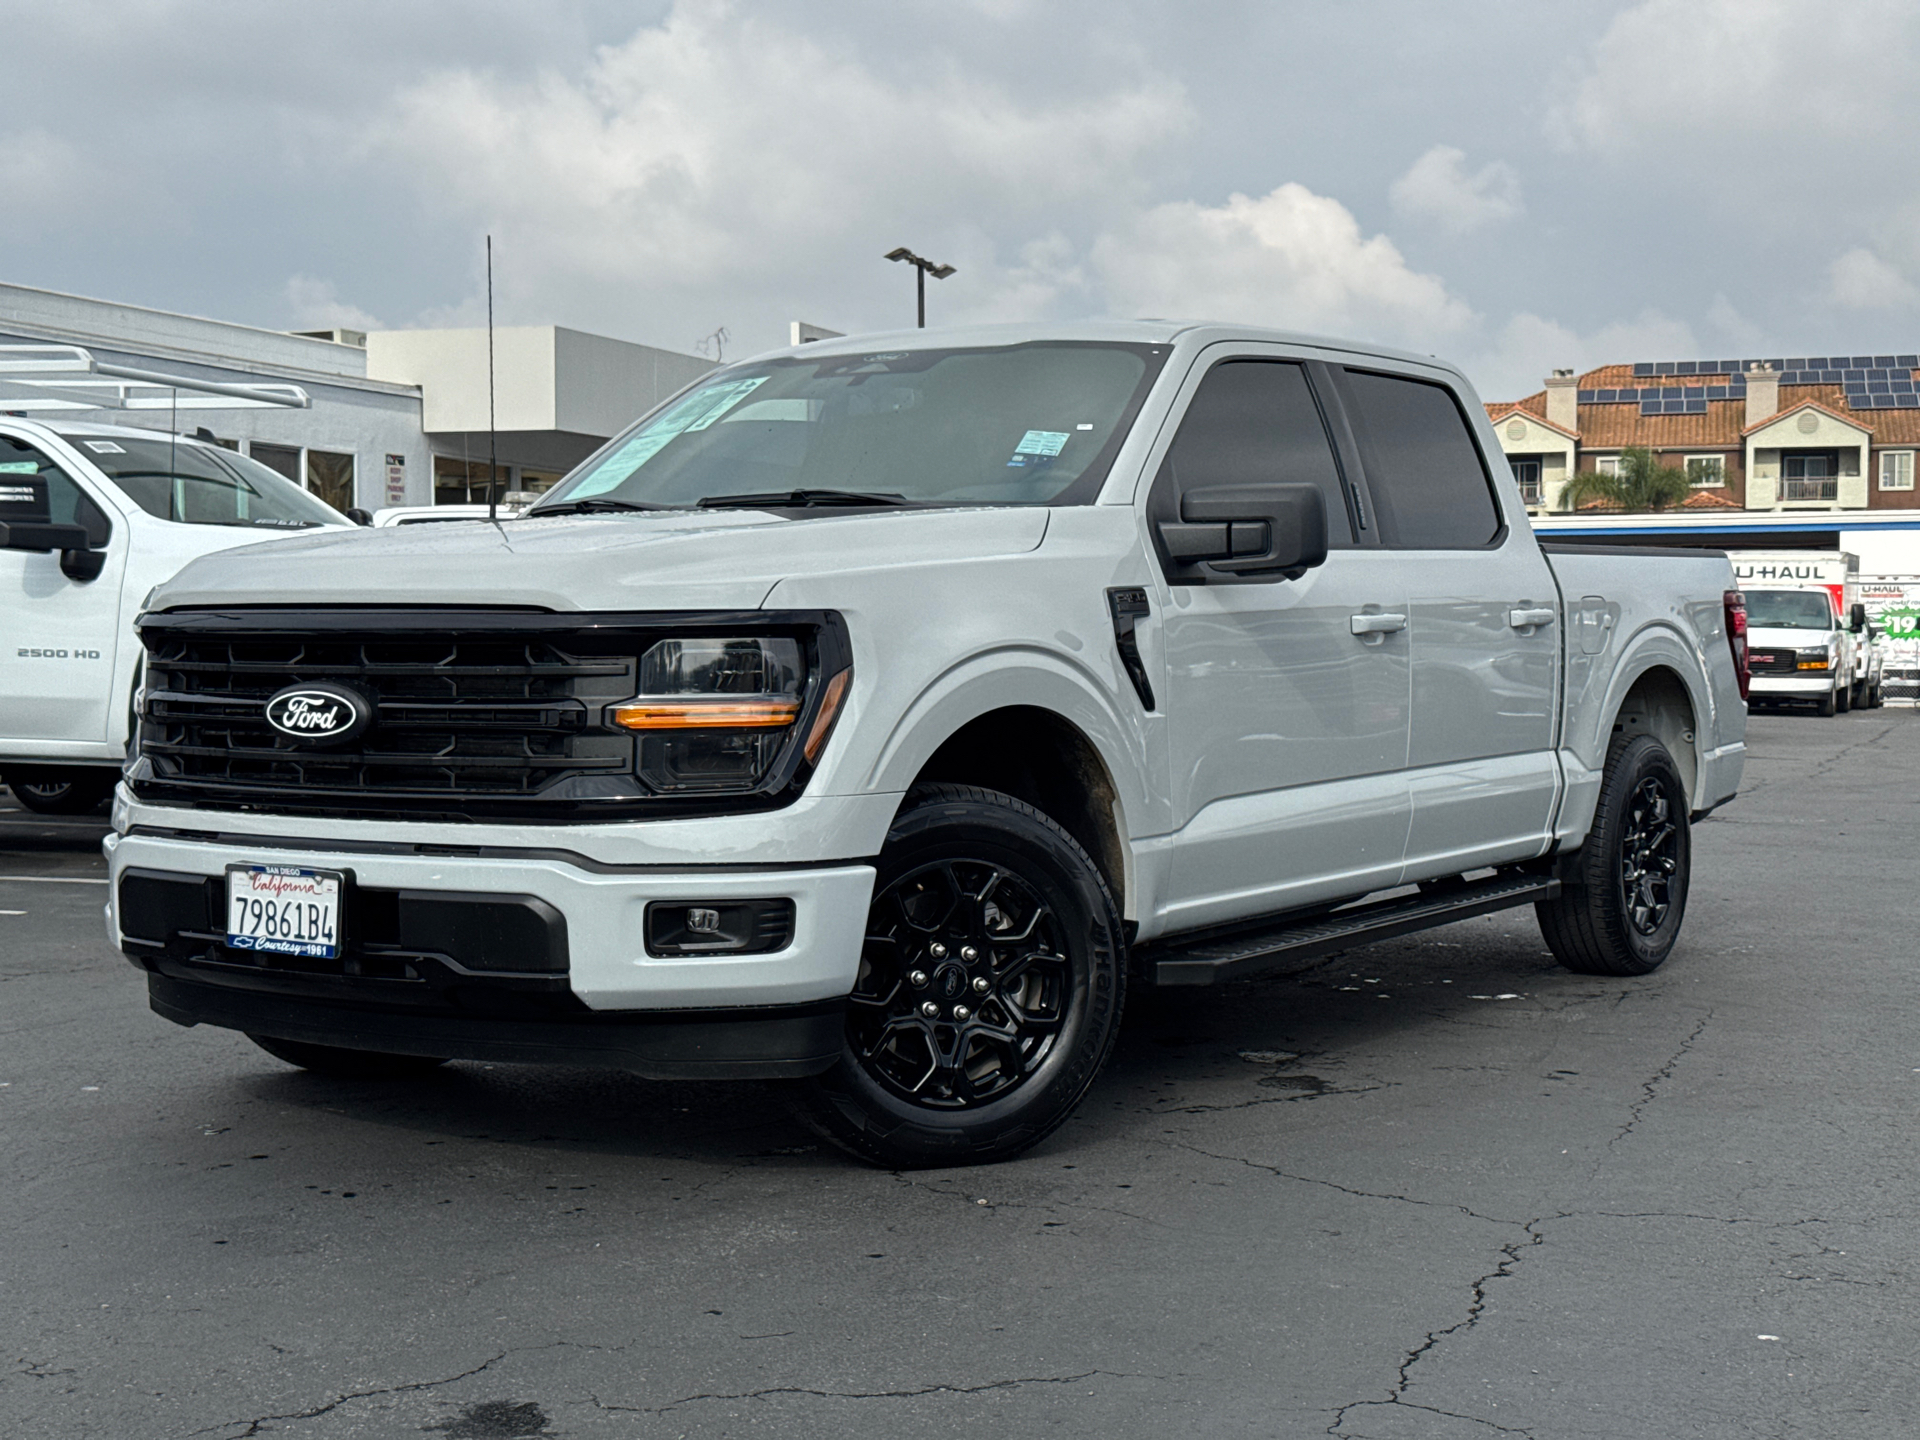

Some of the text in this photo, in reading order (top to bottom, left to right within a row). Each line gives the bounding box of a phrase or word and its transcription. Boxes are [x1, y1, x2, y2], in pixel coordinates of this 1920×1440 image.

[17, 648, 100, 659] 2500 HD
[283, 697, 338, 729] Ford
[265, 866, 301, 876] SAN DIEGO
[252, 873, 323, 897] California
[235, 897, 334, 943] 79861B4
[255, 936, 327, 956] Courtesy 1961
